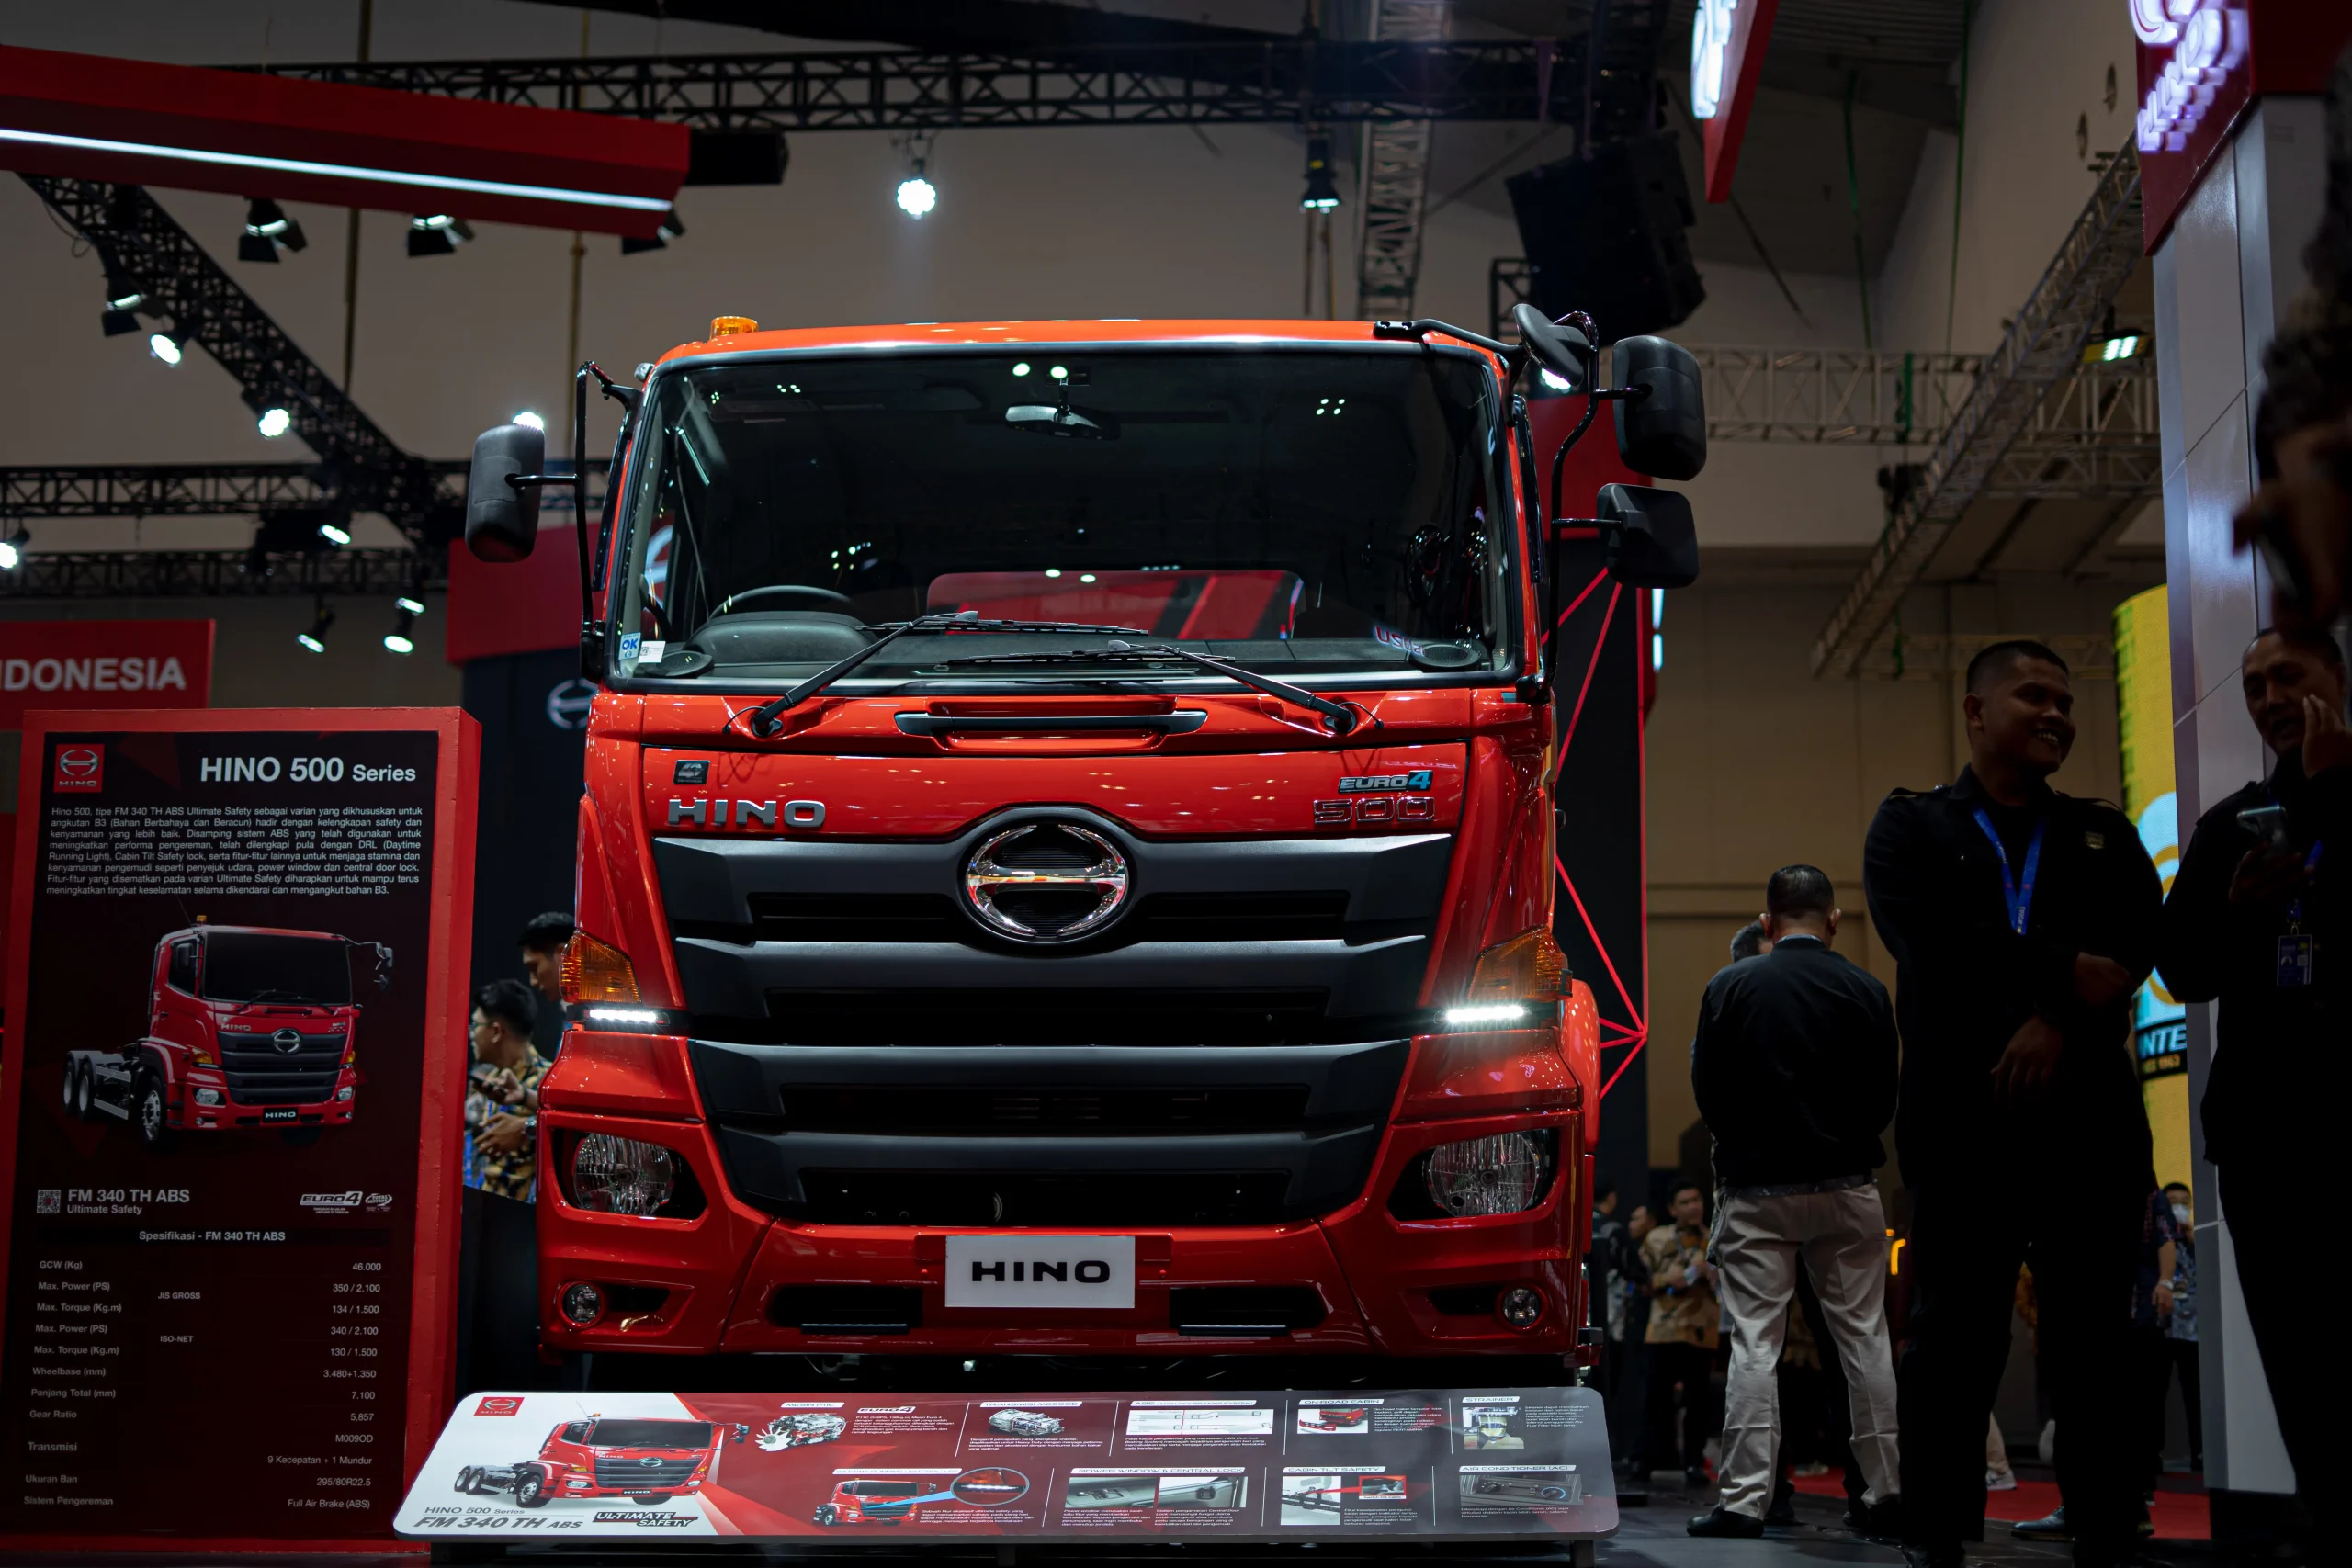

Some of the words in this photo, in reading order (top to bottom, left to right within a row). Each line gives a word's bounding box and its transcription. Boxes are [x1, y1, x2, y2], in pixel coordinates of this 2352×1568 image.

[623, 637, 638, 650] OK
[0, 657, 187, 692] DONESIA
[201, 757, 280, 782] HINO
[290, 757, 344, 782] 500
[352, 764, 416, 782] Series
[1340, 771, 1431, 789] EURO4
[96, 808, 111, 817] tipe
[225, 807, 252, 817] Safety
[254, 807, 288, 817] sebagai
[319, 808, 340, 817] yang
[342, 807, 396, 816] dikhususkan
[399, 807, 423, 815] untuk
[668, 799, 826, 828] HINO
[1314, 796, 1434, 824] 500
[51, 819, 89, 828] angkutan
[111, 818, 140, 827] (Bahan
[144, 818, 189, 828] Berbahaya
[214, 818, 252, 827] Beracun)
[281, 818, 313, 828] dengan
[318, 818, 371, 828] kelengkapan
[376, 818, 401, 828] safety
[51, 830, 103, 839] kenyamanan
[187, 829, 232, 840] Disamping
[237, 829, 265, 838] sistem
[270, 829, 289, 838] ABS
[295, 831, 316, 840] yang
[321, 829, 342, 838] telah
[347, 829, 391, 840] digunakan
[397, 829, 421, 838] untuk
[69, 1189, 92, 1201] FM
[97, 1190, 125, 1202] 340
[130, 1190, 151, 1202] TH
[155, 1189, 189, 1202] ABS
[302, 1193, 359, 1204] EURO4
[67, 1204, 108, 1213] Ultimate
[111, 1204, 142, 1215] Safety
[140, 1231, 195, 1242] Spesifikasi
[206, 1231, 221, 1240] FM
[224, 1232, 243, 1240] 340
[245, 1232, 260, 1240] TH
[263, 1232, 286, 1241] ABS
[40, 1260, 62, 1269] GCW
[64, 1261, 83, 1270] (Kg)
[972, 1259, 1111, 1283] HINO
[39, 1281, 59, 1290] Max.
[93, 1282, 110, 1292] (PS)
[356, 1284, 380, 1292] 2.100
[61, 1303, 91, 1313] Torque
[93, 1303, 122, 1313] (Kg.m)
[333, 1305, 347, 1314] 134
[356, 1305, 379, 1314] 1.500
[59, 1325, 87, 1333] Power
[90, 1325, 107, 1334] (PS)
[331, 1326, 346, 1335] 340
[355, 1326, 379, 1335] 2.100
[58, 1346, 88, 1355] Torque
[90, 1346, 119, 1356] (Kg.m)
[355, 1348, 378, 1357] 1.500
[33, 1367, 81, 1375] Wheelbase
[84, 1368, 106, 1377] (mm)
[323, 1370, 377, 1378] 3.480+1.350
[31, 1389, 67, 1398] Panjang
[94, 1389, 116, 1398] (mm)
[29, 1410, 51, 1418] Gear
[53, 1410, 77, 1418] Ratio
[28, 1441, 77, 1451] Transmisi
[276, 1456, 321, 1465] Kecepatan
[339, 1456, 372, 1464] Mundur
[26, 1474, 58, 1483] Ukuran
[61, 1474, 77, 1483] Ban
[317, 1478, 371, 1486] 295/80R22.5
[24, 1496, 54, 1505] Sistem
[57, 1496, 114, 1506] Pengereman
[288, 1499, 303, 1507] Full
[305, 1499, 317, 1507] Air
[319, 1499, 344, 1507] Brake
[346, 1499, 370, 1509] (ABS)
[413, 1517, 458, 1527] FM
[457, 1517, 509, 1528] 340
[510, 1517, 548, 1528] TH
